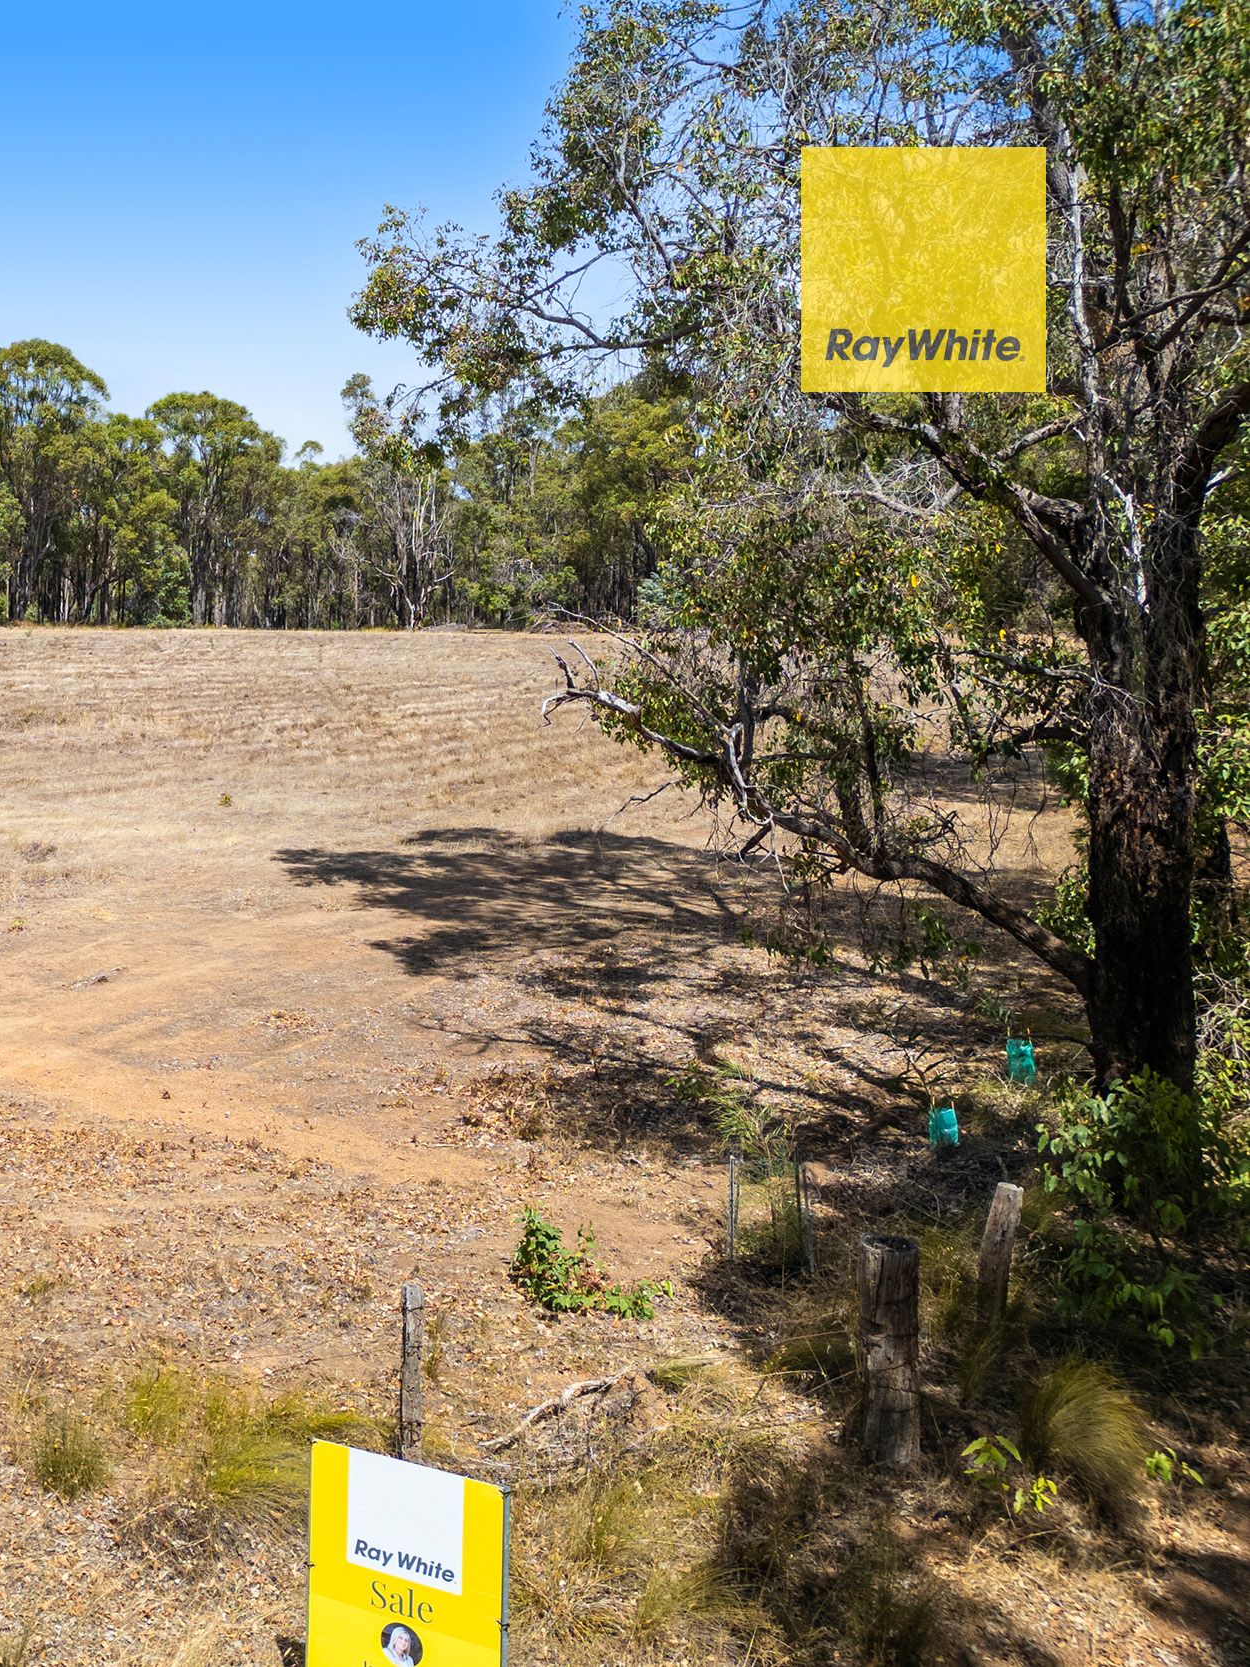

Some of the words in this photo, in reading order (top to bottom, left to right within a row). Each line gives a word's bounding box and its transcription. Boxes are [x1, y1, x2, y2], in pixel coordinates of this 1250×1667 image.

[354, 1539, 393, 1566] Ray
[398, 1551, 455, 1582] White
[371, 1581, 433, 1623] Sale
